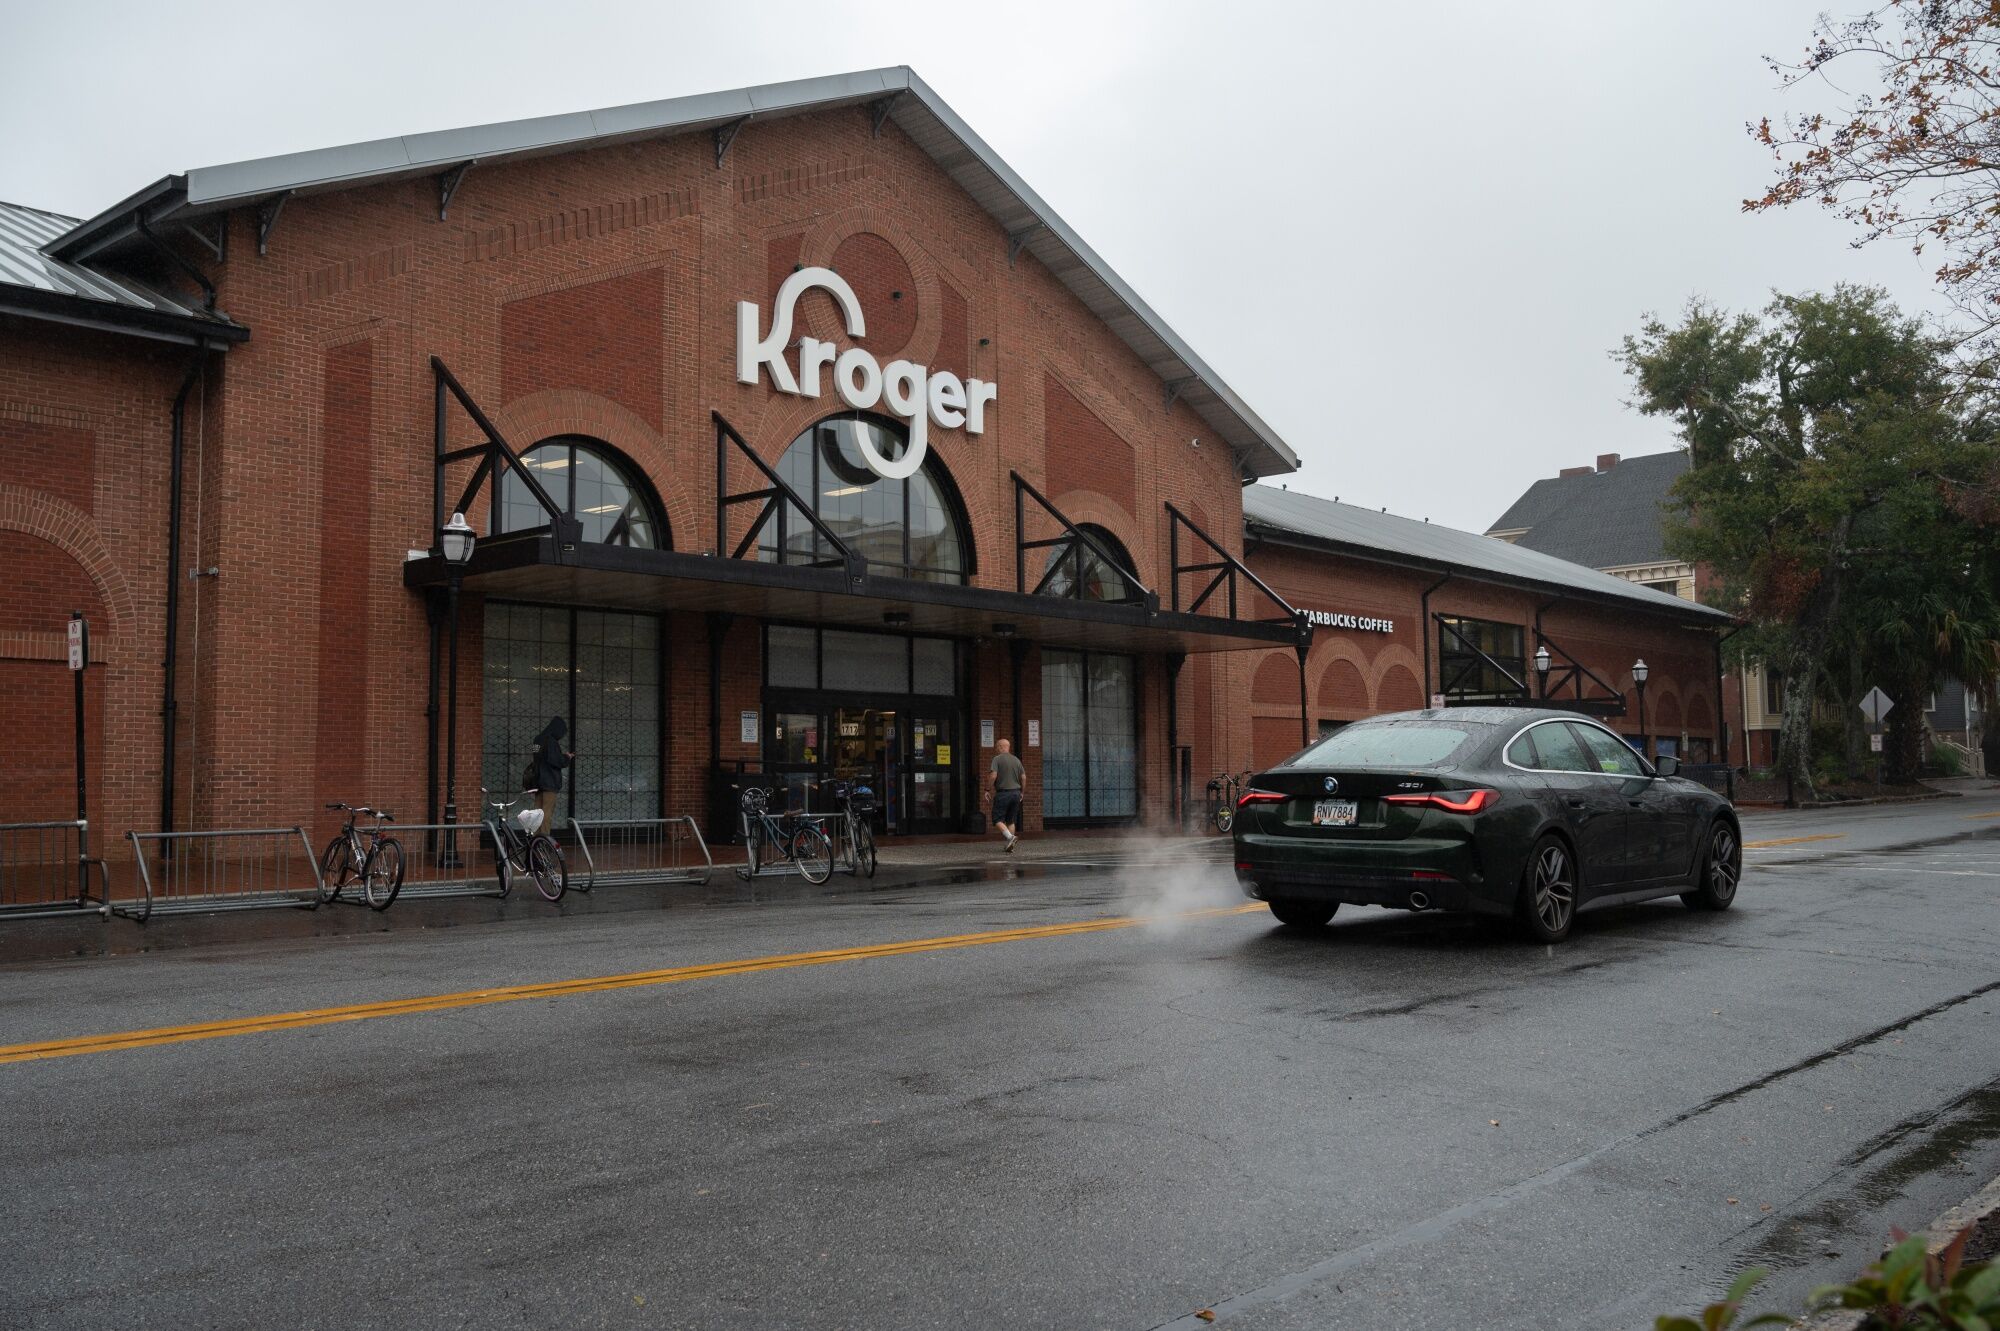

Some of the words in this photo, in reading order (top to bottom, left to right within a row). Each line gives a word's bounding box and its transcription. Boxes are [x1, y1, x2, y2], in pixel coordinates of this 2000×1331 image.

[736, 266, 997, 480] Kroger
[1358, 616, 1393, 633] COFFEE
[1316, 805, 1353, 819] RNV7884
